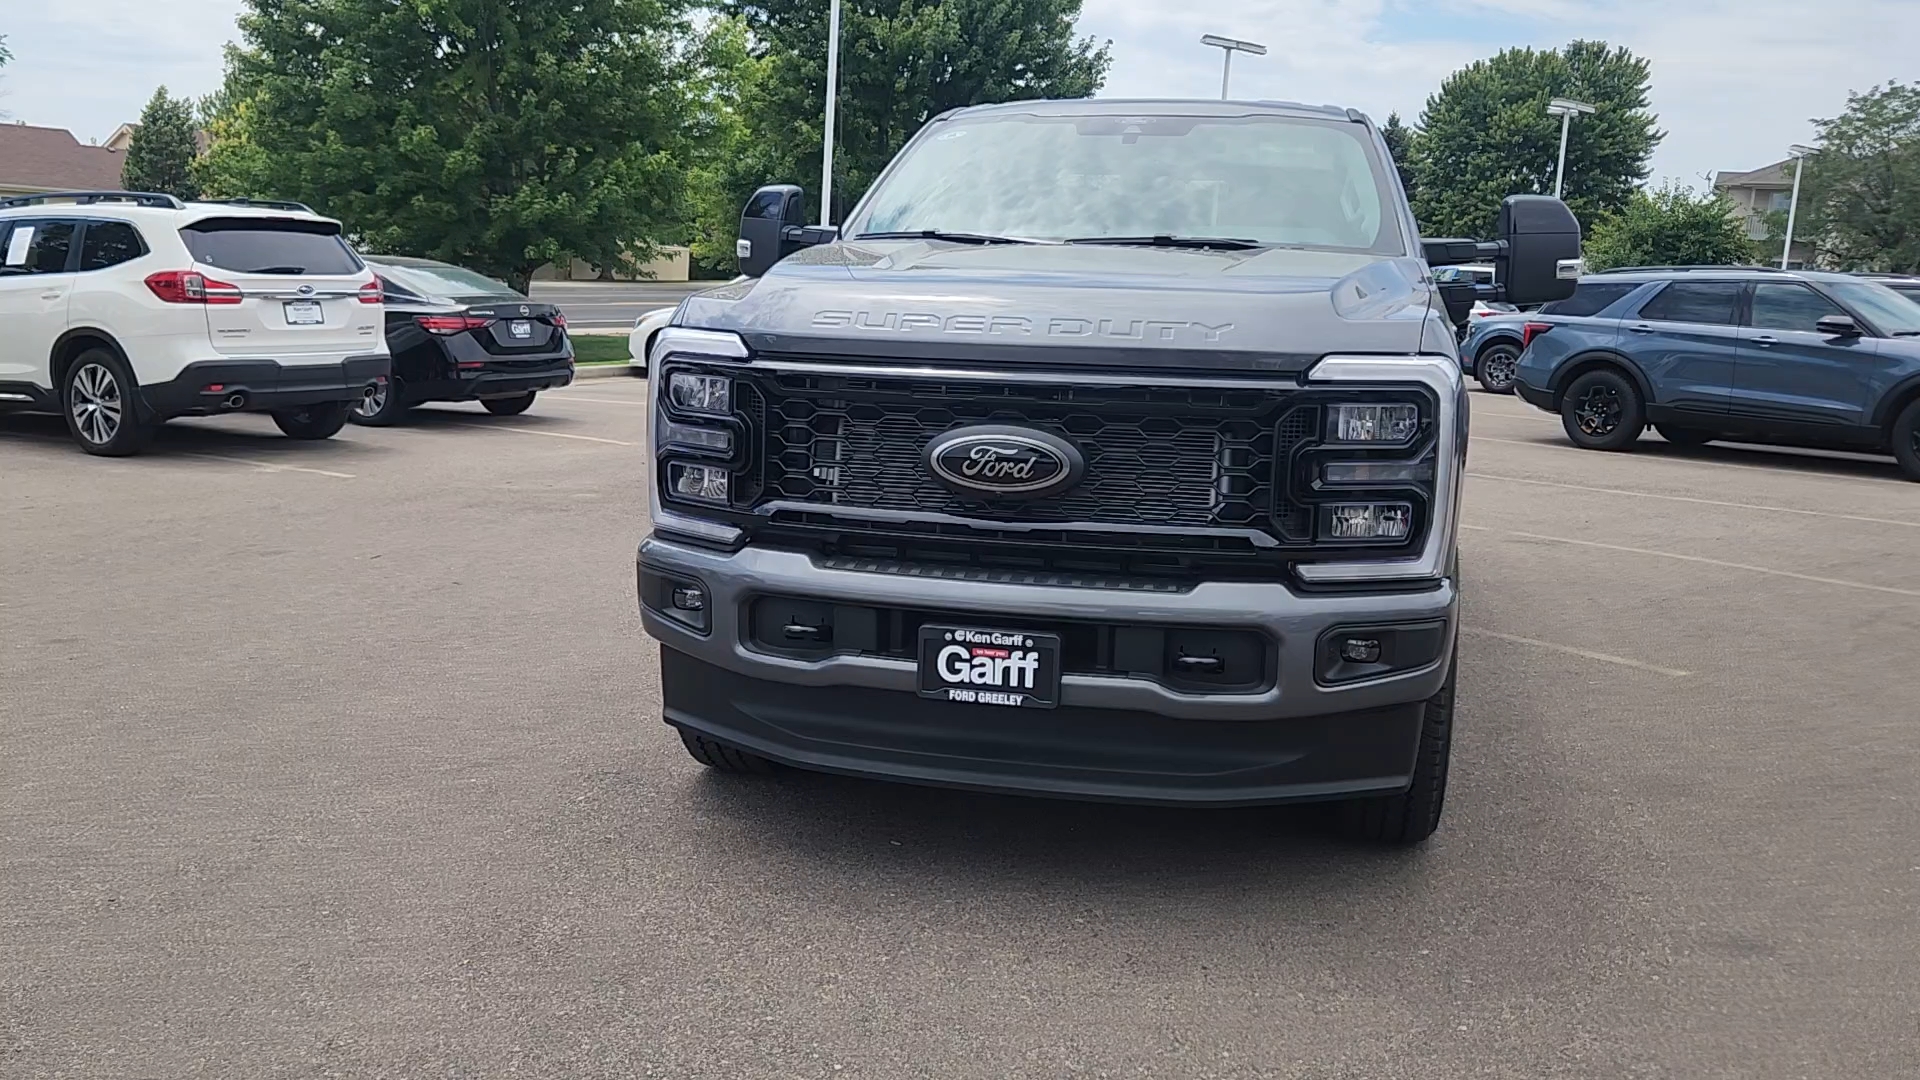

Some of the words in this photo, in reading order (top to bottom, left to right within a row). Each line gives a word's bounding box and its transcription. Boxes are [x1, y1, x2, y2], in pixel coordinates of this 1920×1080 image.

[811, 310, 1032, 336] SUPER
[1047, 317, 1235, 342] DUTY
[961, 445, 1038, 479] Ford
[966, 631, 991, 644] Ken
[991, 633, 1024, 646] Garff
[937, 645, 1039, 689] Garff
[949, 689, 976, 702] FORD
[977, 692, 1024, 706] GREELEY
